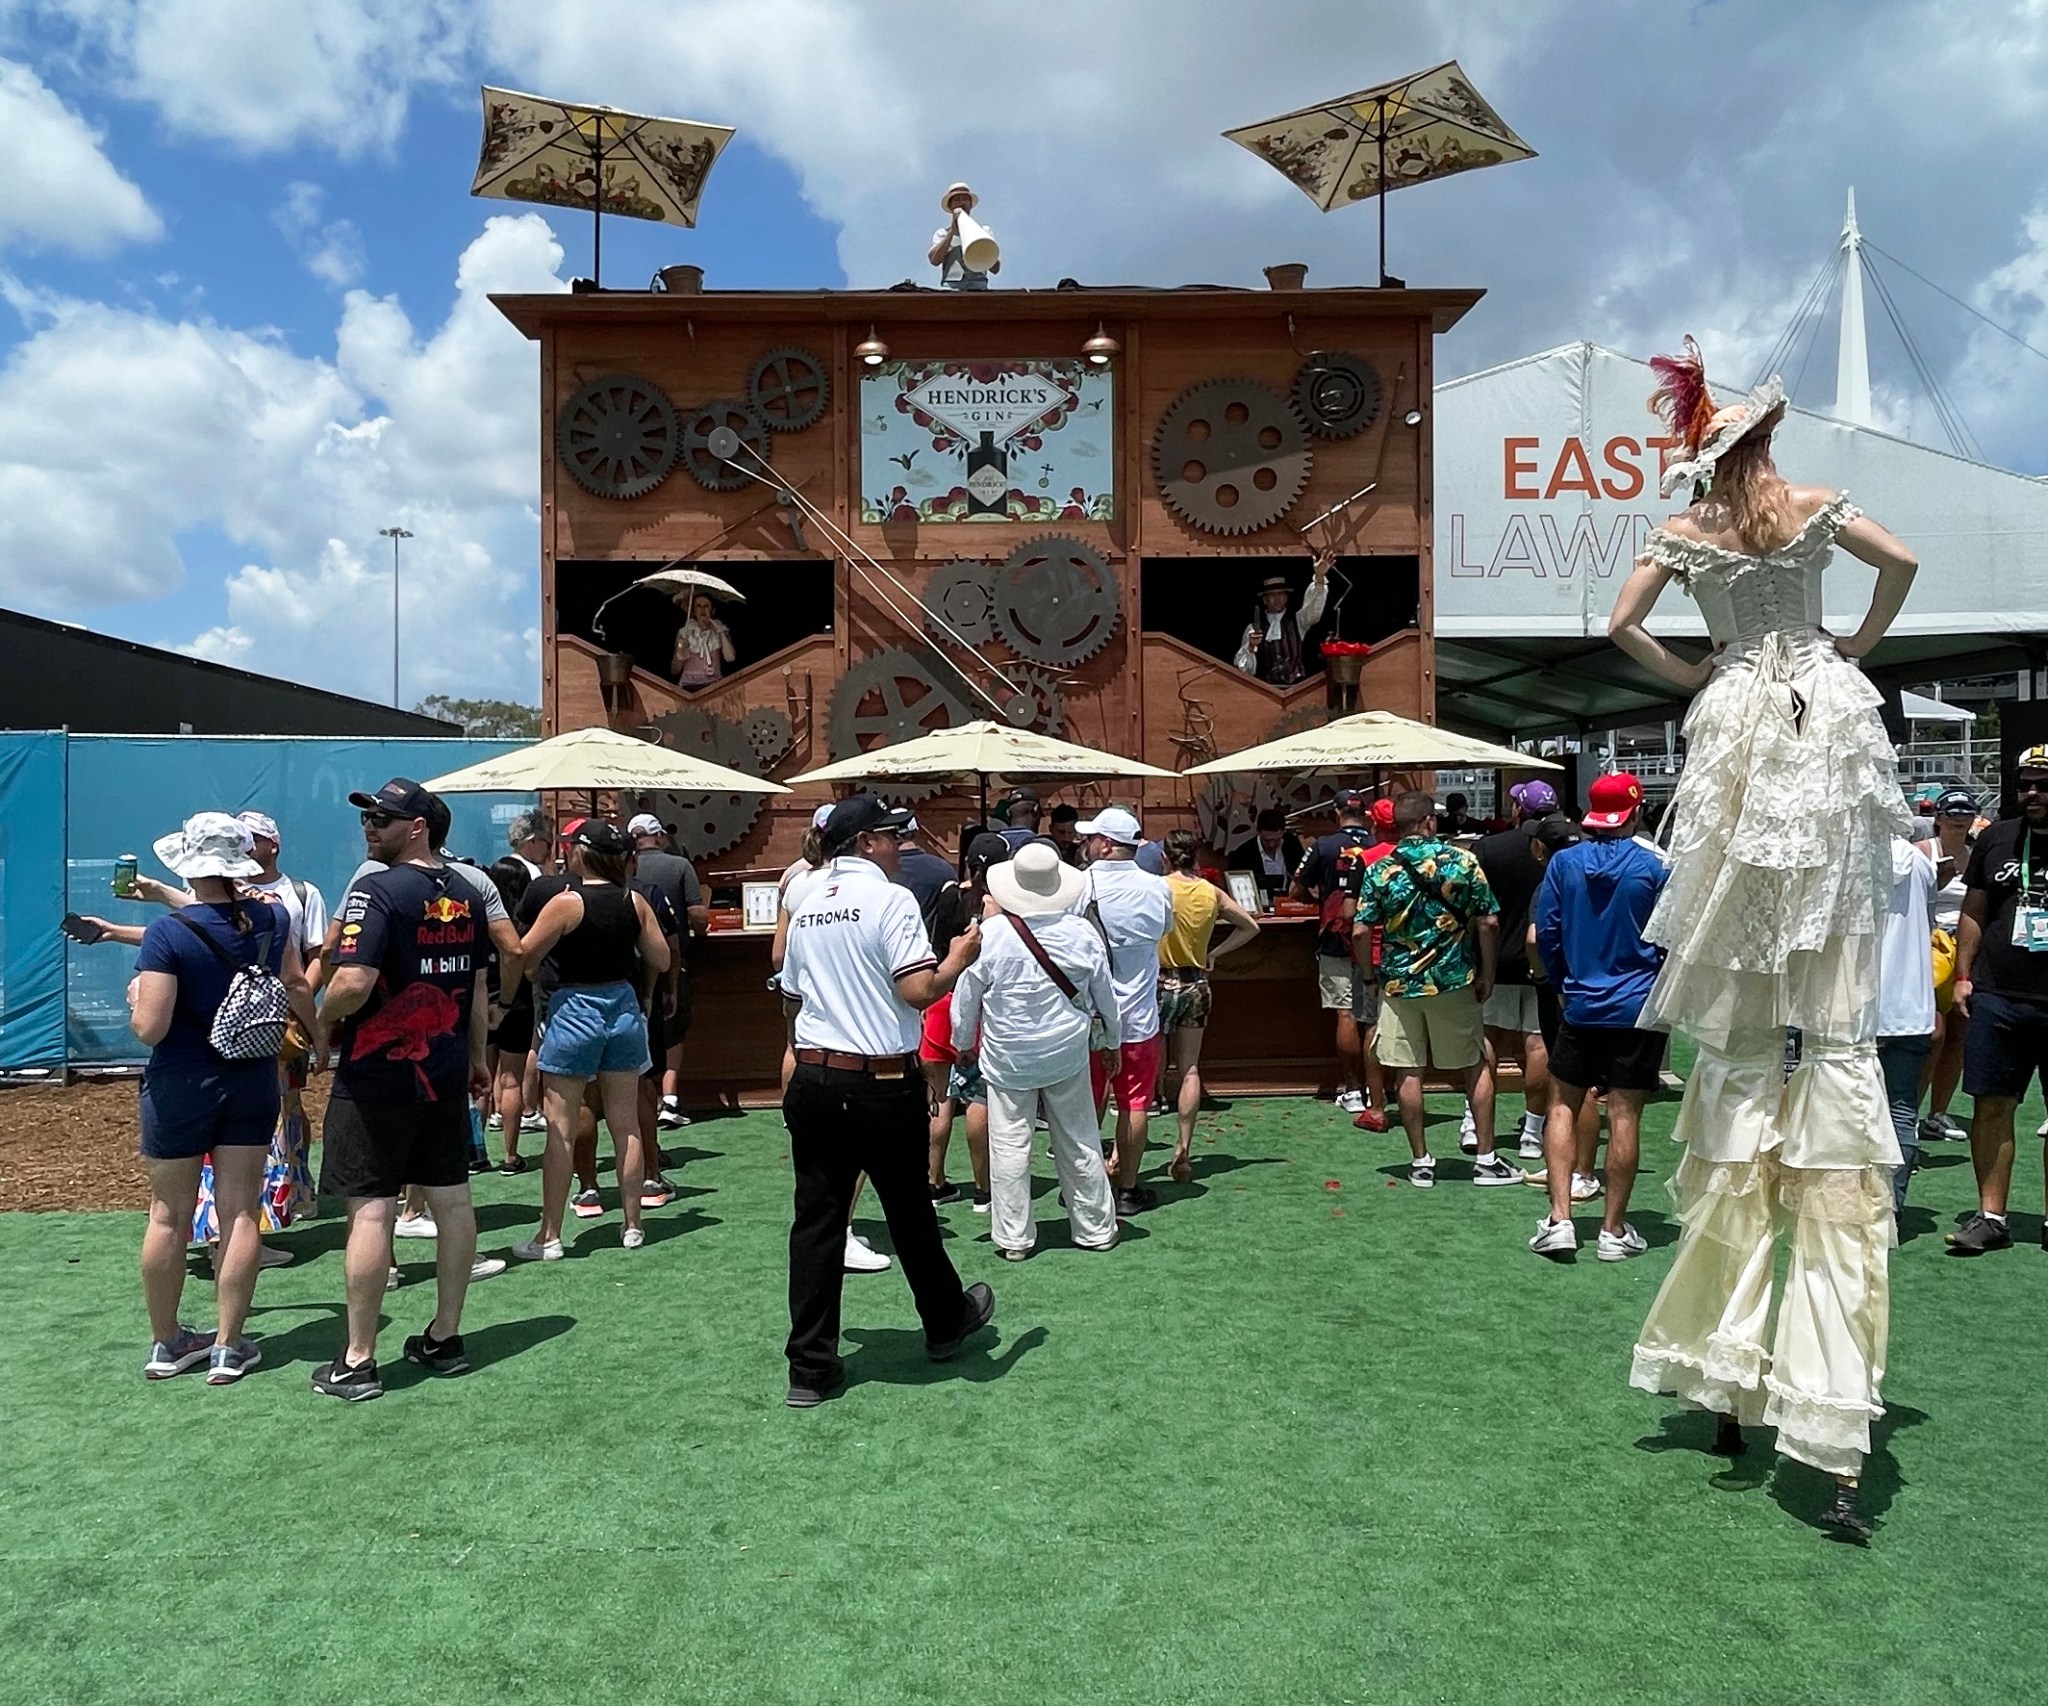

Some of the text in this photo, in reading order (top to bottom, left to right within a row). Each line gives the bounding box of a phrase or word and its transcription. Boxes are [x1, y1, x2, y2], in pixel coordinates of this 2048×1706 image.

[927, 388, 1048, 405] HENDRICK'S
[970, 411, 1005, 421] GIN
[1503, 435, 1684, 500] EAST
[795, 908, 861, 930] PETRONAS
[417, 922, 475, 945] Red Bull
[420, 955, 456, 975] Mobil
